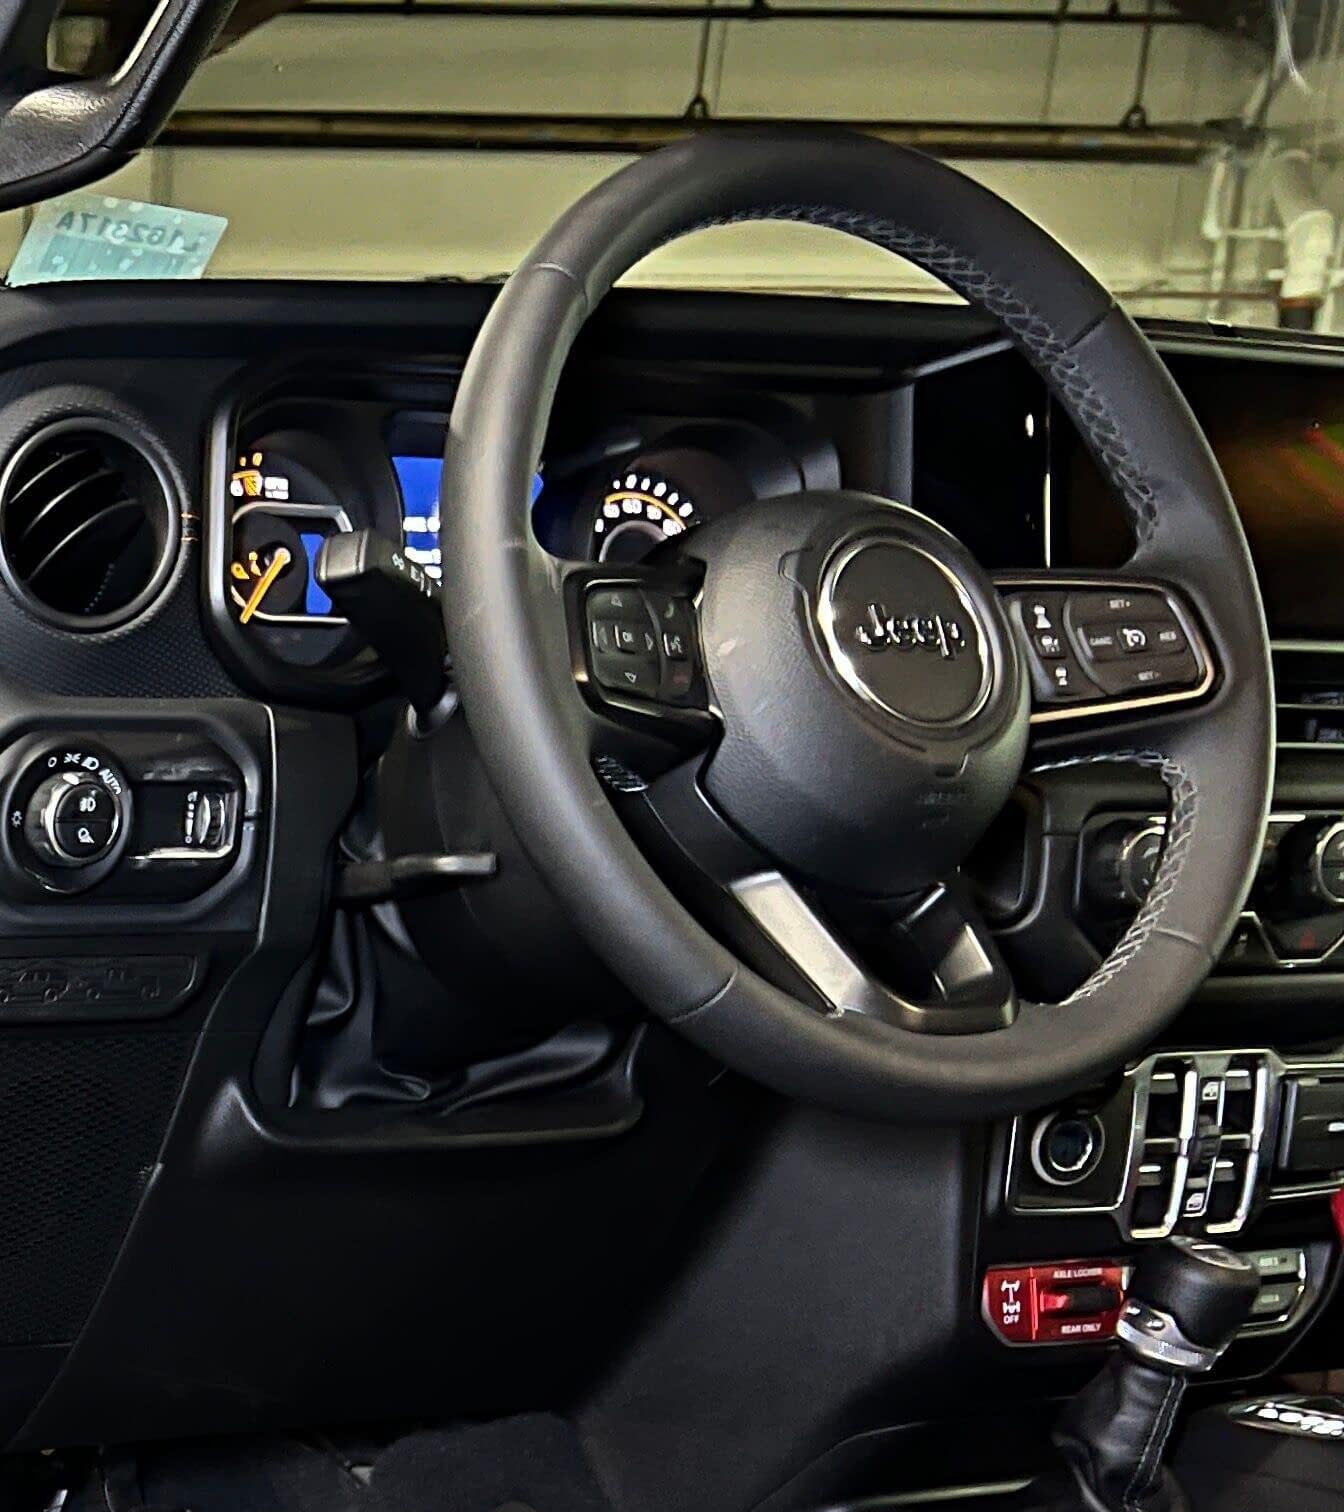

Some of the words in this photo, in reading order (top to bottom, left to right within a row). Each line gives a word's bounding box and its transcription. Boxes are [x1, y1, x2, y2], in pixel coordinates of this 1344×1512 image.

[855, 604, 966, 657] Jeep
[99, 768, 122, 795] AUTO
[1003, 1314, 1020, 1325] OFF
